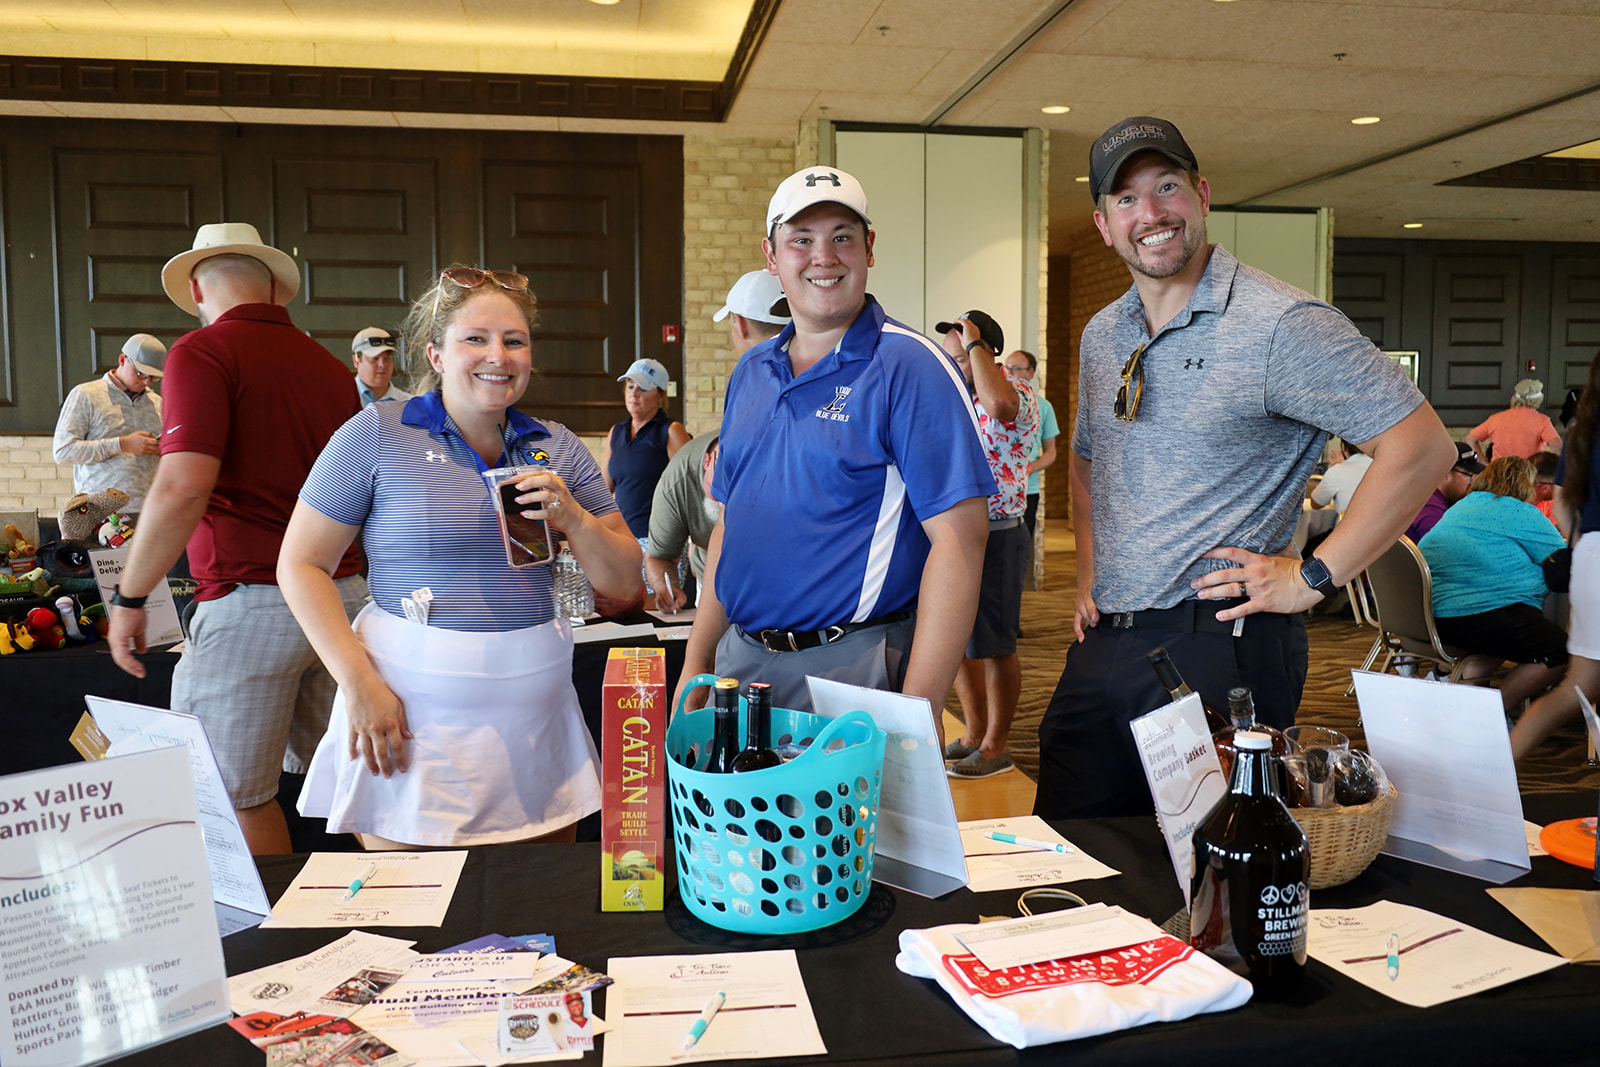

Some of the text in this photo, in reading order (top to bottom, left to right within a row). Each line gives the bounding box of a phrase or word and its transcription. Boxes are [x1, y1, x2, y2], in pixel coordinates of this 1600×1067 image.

[815, 410, 850, 423] BLUE DEVILS
[96, 560, 115, 568] Dino
[99, 566, 126, 575] Deligh
[617, 697, 654, 709] CATAN
[622, 716, 651, 805] CATAN
[1147, 743, 1178, 767] Brewing
[1153, 743, 1208, 782] Company Basket
[0, 780, 113, 816] ox Valley
[0, 801, 124, 840] amily Fun
[621, 811, 648, 819] TRADE
[619, 828, 648, 836] SETTLE
[0, 880, 77, 909] ncludes:
[34, 907, 43, 917] to
[122, 883, 141, 894] Seat
[142, 877, 169, 889] Tickets
[169, 874, 179, 882] to
[142, 891, 154, 900] for
[155, 887, 172, 896] Kids
[179, 881, 195, 889] Year
[140, 902, 154, 912] $25
[155, 894, 183, 906] Ground
[1257, 903, 1307, 920] STILLMA
[1, 946, 29, 959] Round
[31, 941, 47, 951] Gift
[128, 915, 145, 924] Free
[146, 907, 176, 920] Custard
[177, 901, 195, 912] from
[1264, 915, 1307, 932] BREWIN
[3, 954, 42, 971] Appleton
[43, 945, 79, 960] Culver's,
[144, 922, 161, 932] Park
[162, 916, 180, 926] Free
[1264, 931, 1291, 941] GREEN
[4, 953, 88, 982] Attraction Coupons.
[8, 978, 58, 1002] Donated
[60, 974, 79, 987] by:
[10, 1000, 33, 1015] EAA
[145, 957, 182, 974] Timber
[406, 986, 462, 994] Certificate
[368, 995, 418, 1005] nual
[512, 1000, 562, 1010] SCHEDULE
[12, 1007, 63, 1029] Rattlers,
[14, 1022, 56, 1042] HuHot,
[57, 1006, 99, 1028] Groud
[16, 1035, 55, 1055] Sports
